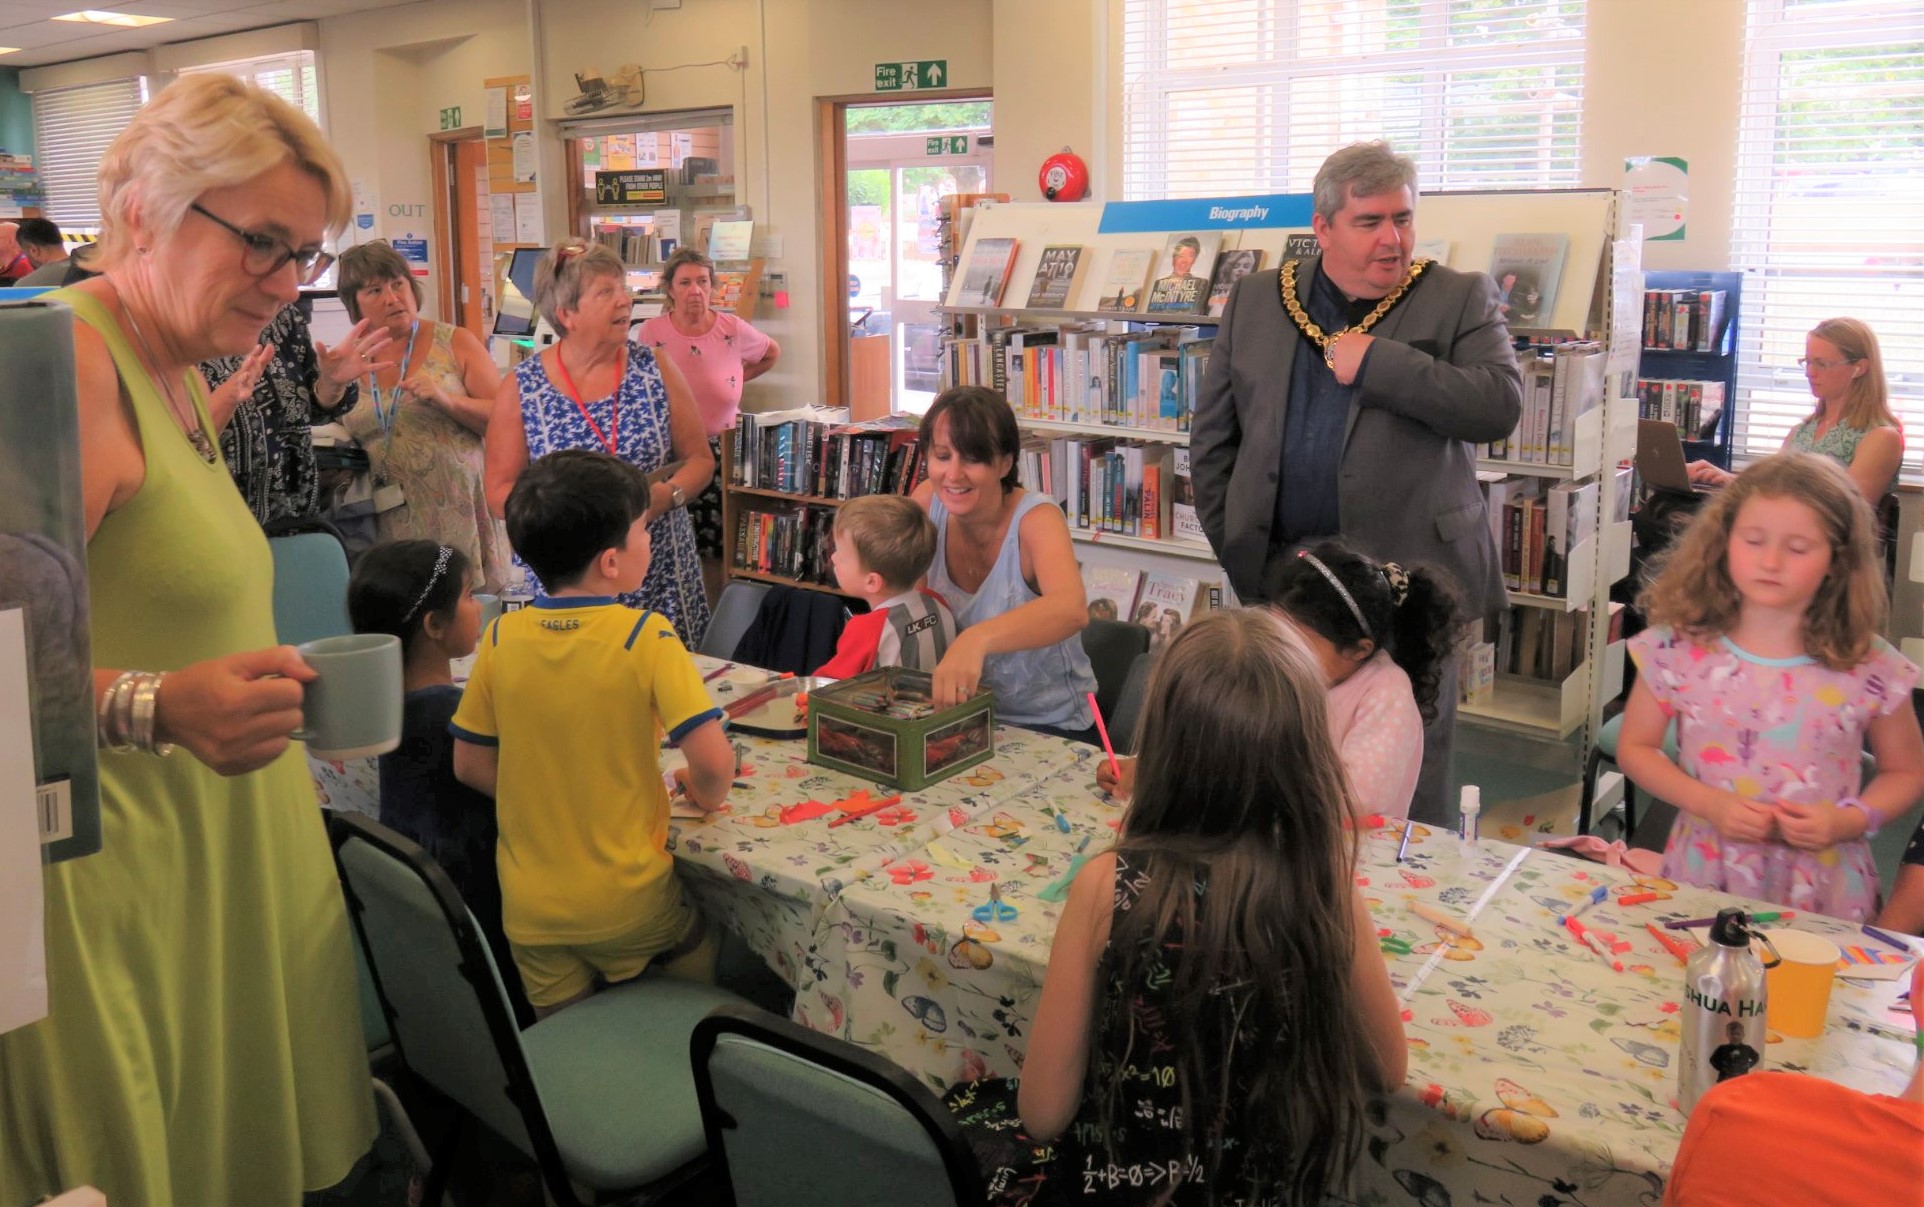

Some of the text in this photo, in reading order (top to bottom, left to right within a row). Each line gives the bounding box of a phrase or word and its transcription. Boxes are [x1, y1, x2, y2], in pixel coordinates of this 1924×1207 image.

[876, 66, 896, 77] Fire
[876, 78, 896, 88] exit
[389, 204, 426, 217] OUT
[1209, 204, 1270, 222] Biography
[1046, 250, 1076, 259] MAY
[1039, 262, 1058, 273] AT
[1158, 280, 1196, 291] MICHAEL
[1152, 291, 1197, 303] McINTYRE
[541, 619, 580, 631] EAGLES
